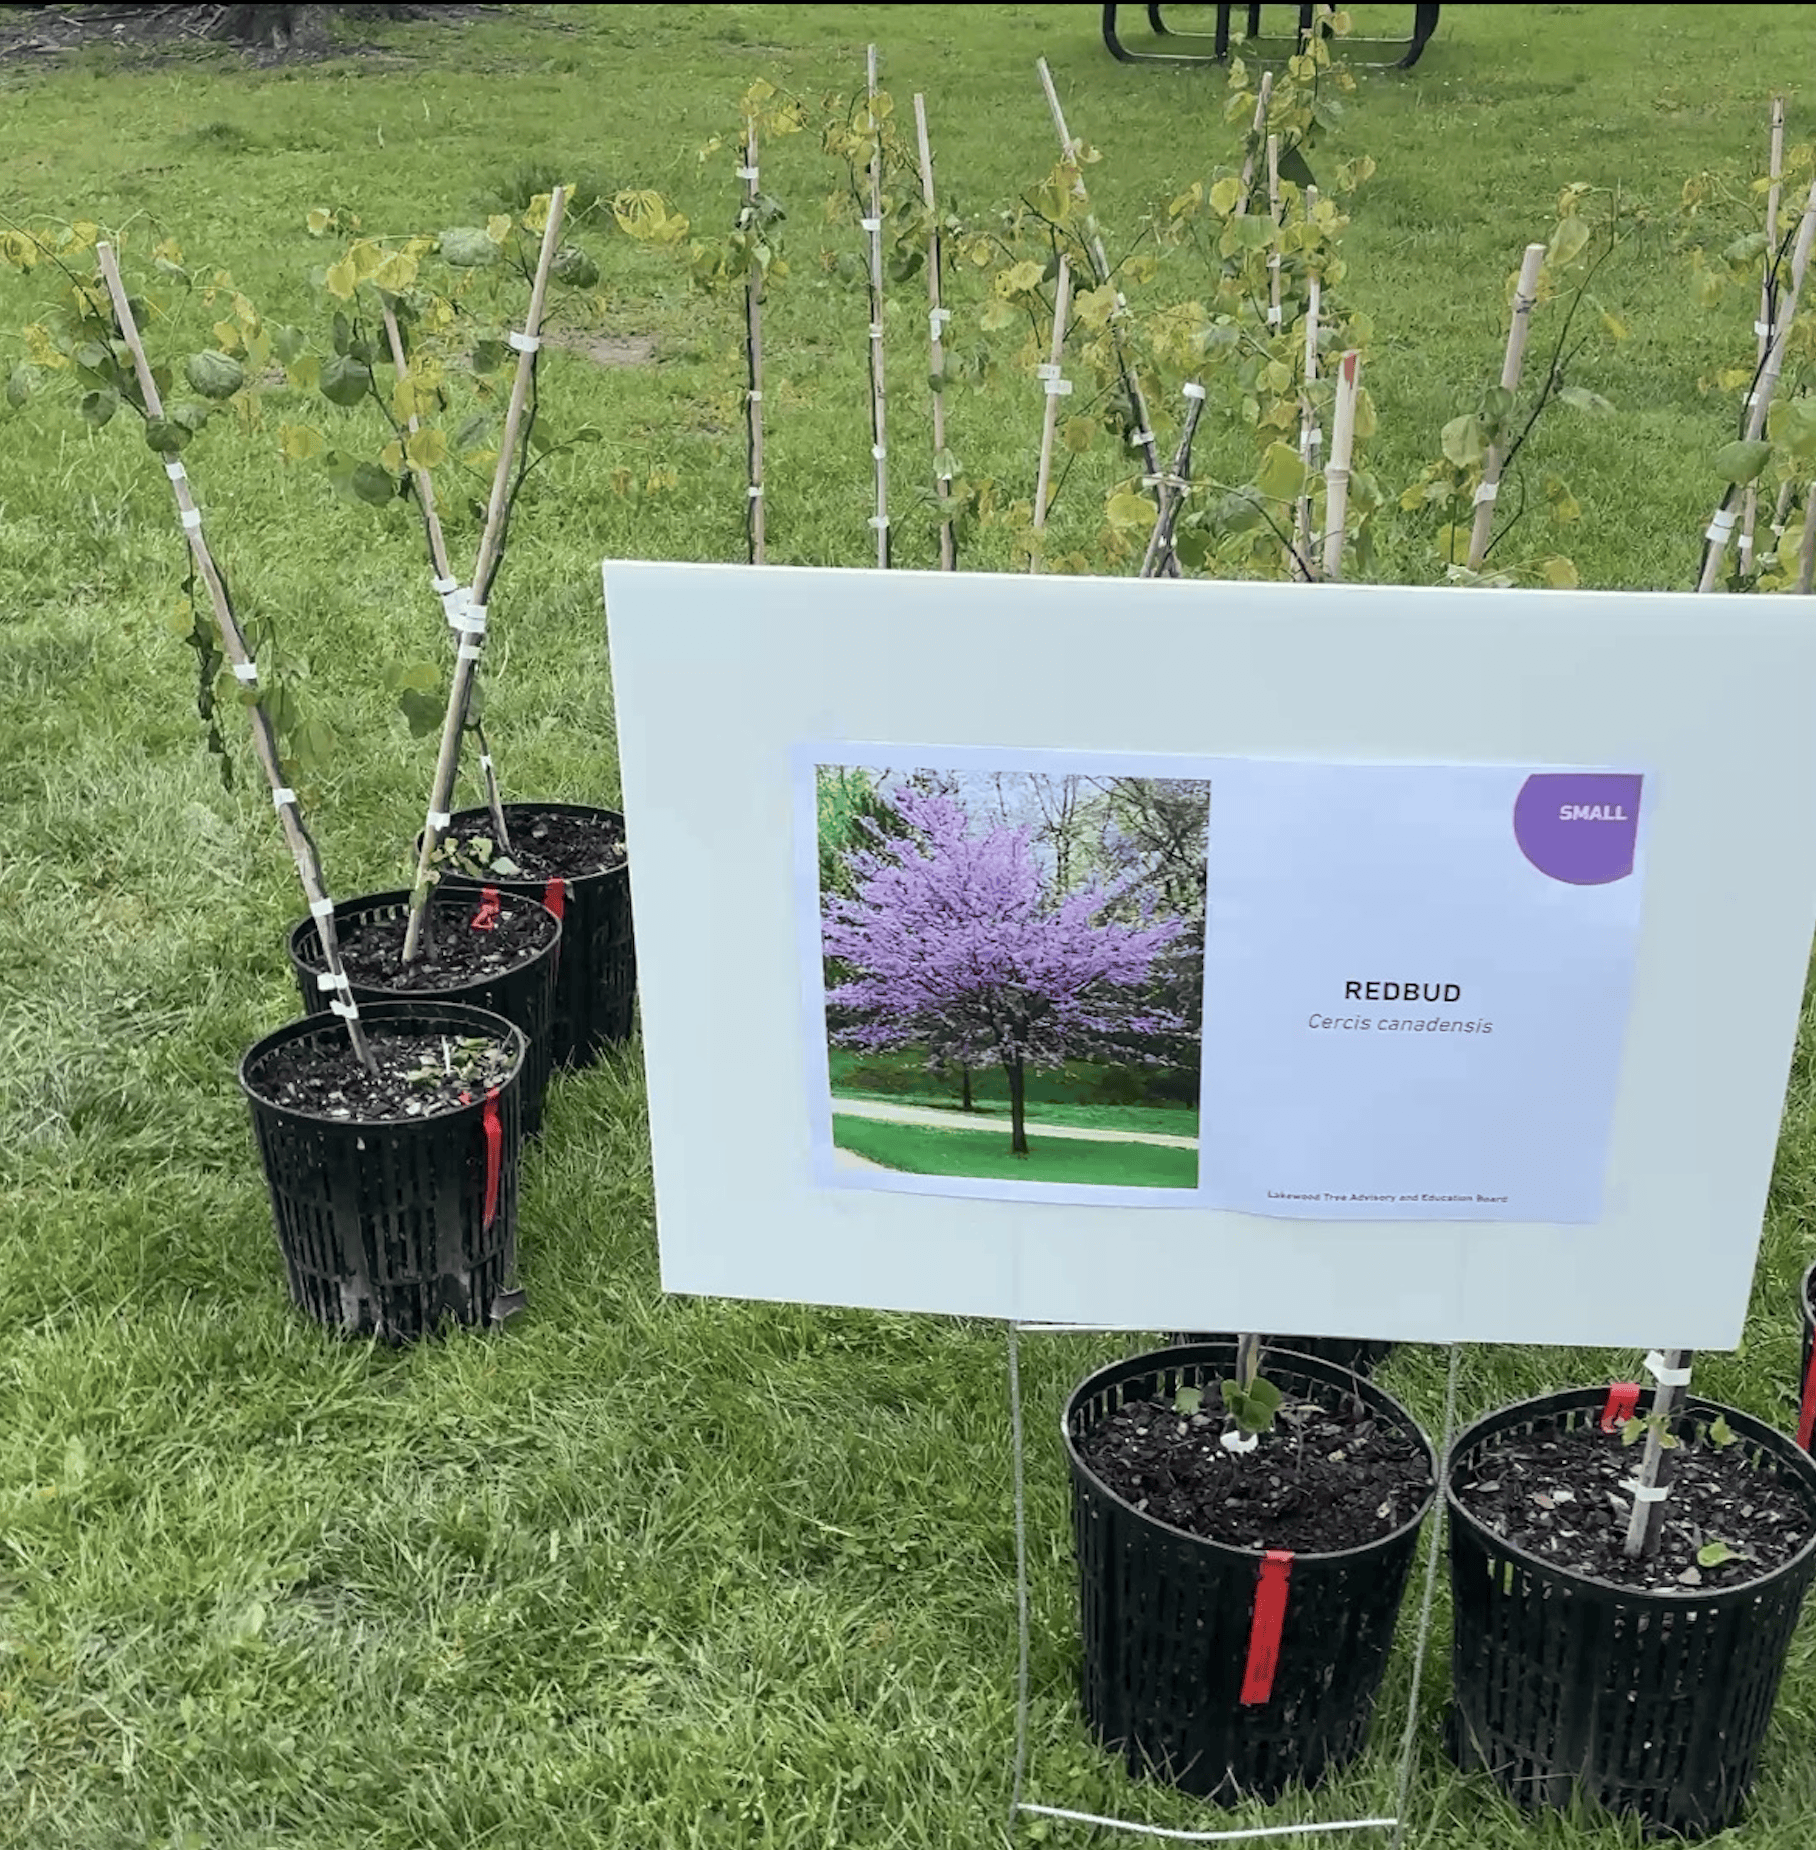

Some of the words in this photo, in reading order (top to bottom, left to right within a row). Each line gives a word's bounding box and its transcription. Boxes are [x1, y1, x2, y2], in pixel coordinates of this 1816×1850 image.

[1559, 805, 1628, 821] SMALL
[1344, 980, 1461, 1002] REDBUD
[1308, 1013, 1372, 1031] Cercis
[1377, 1017, 1494, 1034] canadensis
[1267, 1190, 1321, 1201] Lakewood
[1324, 1192, 1347, 1202] Tree
[1350, 1192, 1396, 1203] Advisory
[1399, 1193, 1419, 1202] and
[1421, 1193, 1473, 1202] Education
[1476, 1194, 1509, 1204] Board
